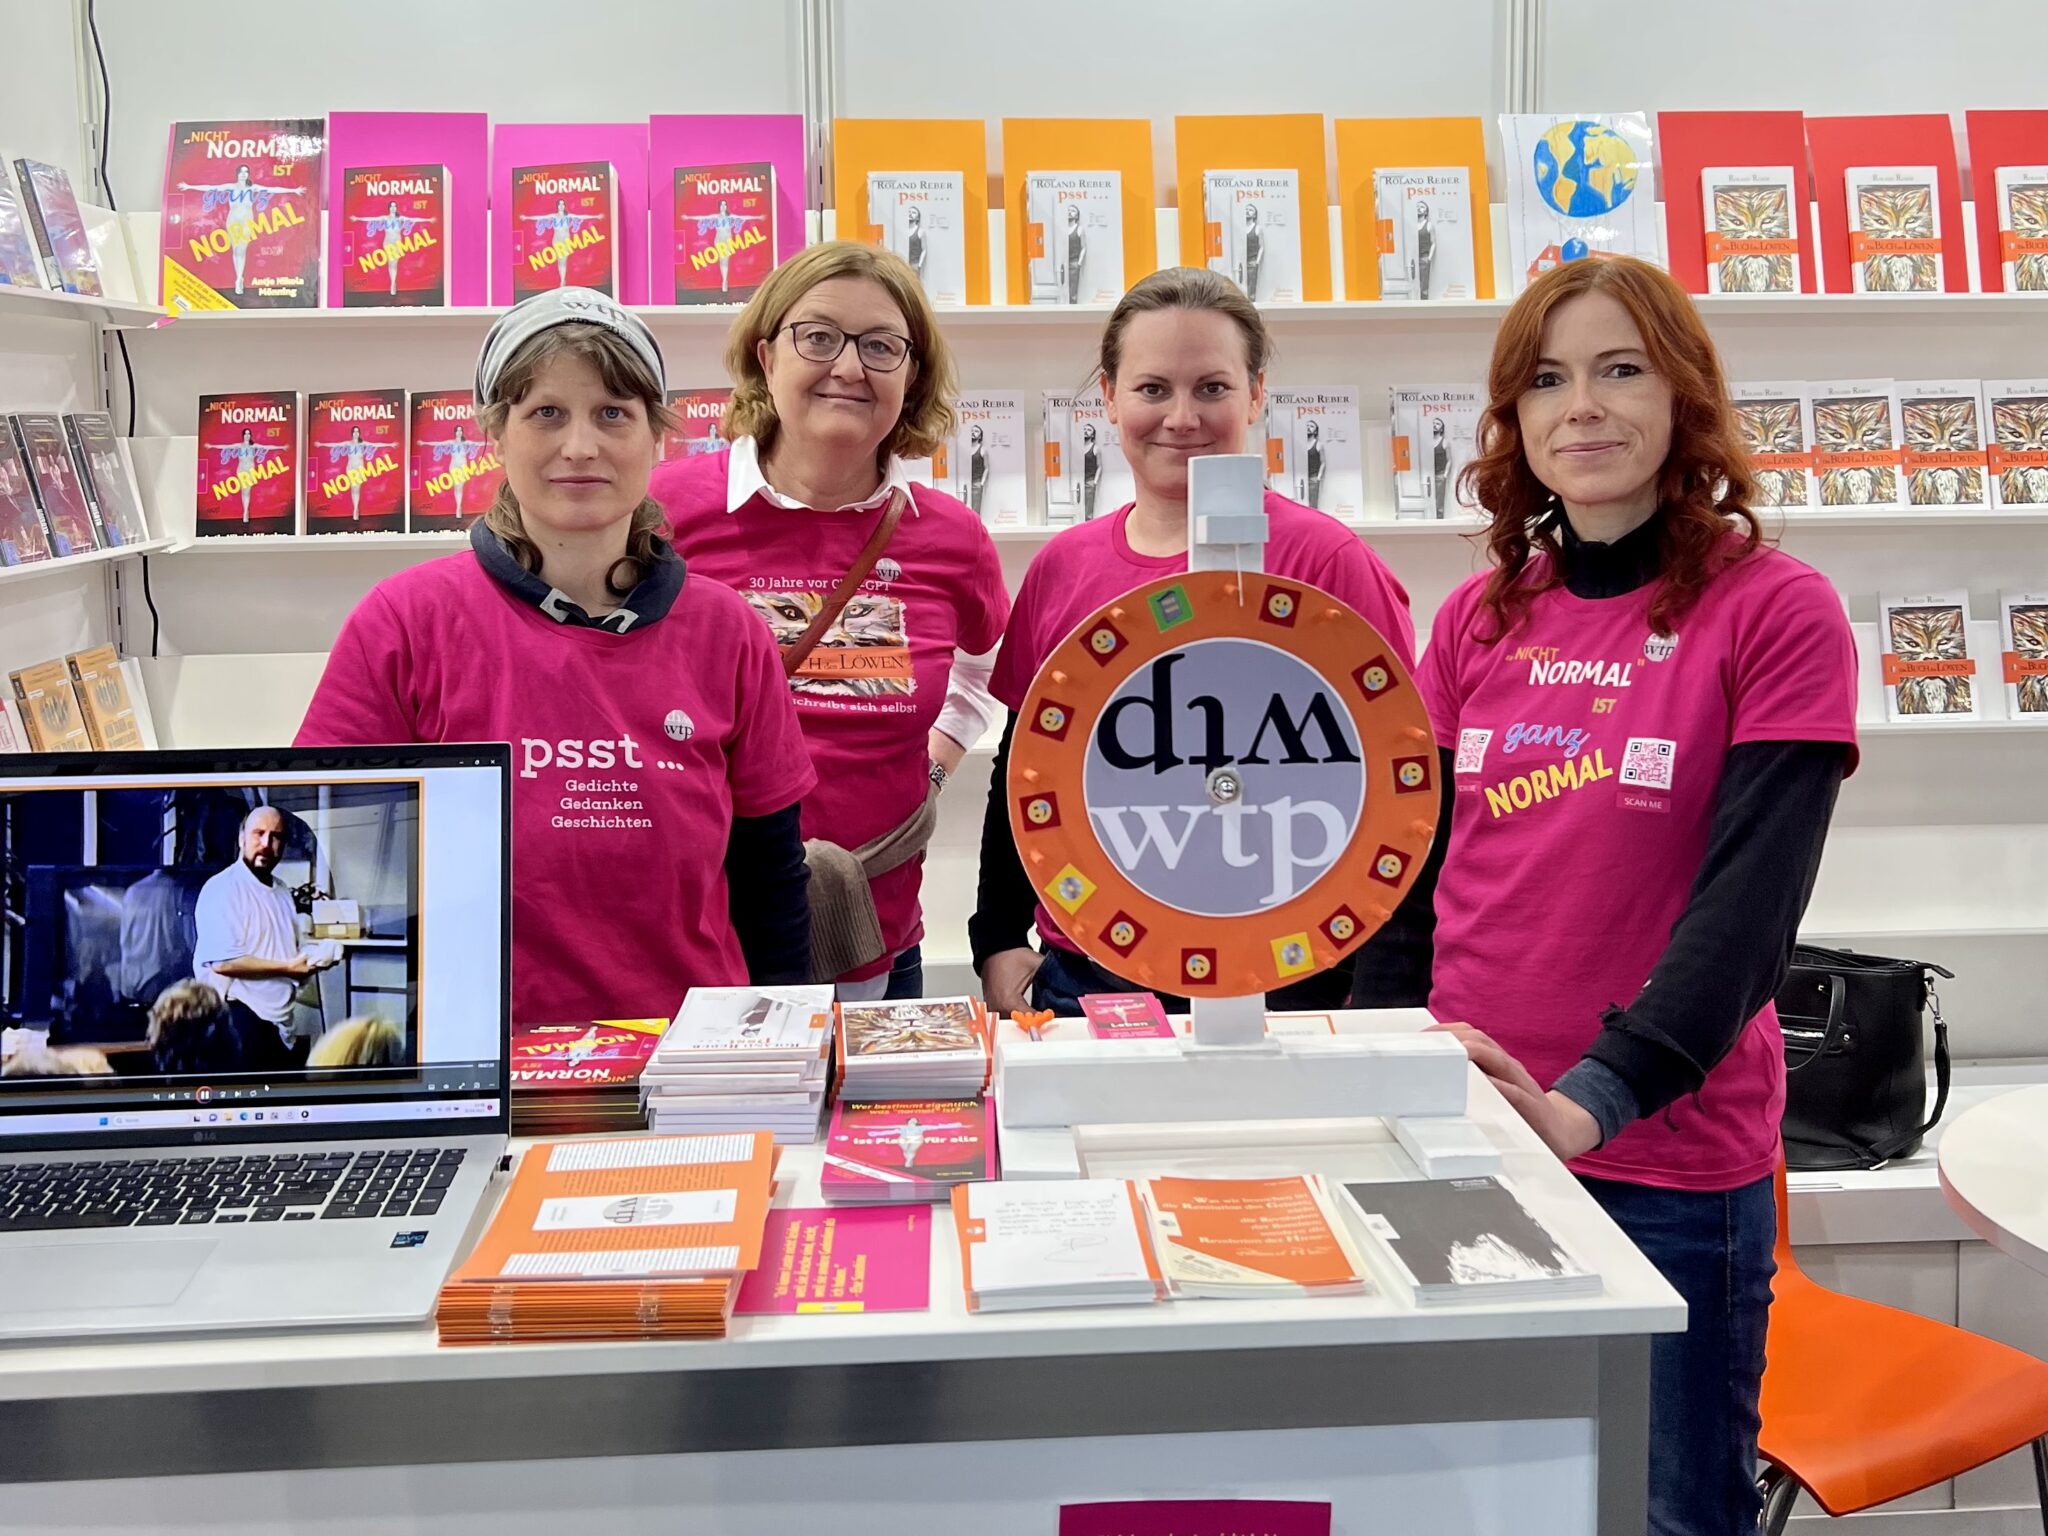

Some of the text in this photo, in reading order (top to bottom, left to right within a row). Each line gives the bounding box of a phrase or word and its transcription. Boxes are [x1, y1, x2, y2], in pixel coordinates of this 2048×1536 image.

[273, 165, 294, 177] IST
[877, 180, 953, 190] ROLAND REBER
[1036, 179, 1112, 190] ROLAND REBER
[1213, 178, 1289, 189] ROLAND REBER
[1385, 175, 1460, 186] ROLAND REBER
[899, 190, 929, 205] psst
[1058, 190, 1088, 203] psst
[1235, 189, 1265, 203] psst
[1406, 185, 1437, 200] psst
[202, 188, 273, 212] ganz
[413, 200, 427, 209] IST
[580, 197, 595, 207] IST
[743, 198, 757, 208] IST
[189, 202, 306, 262] NORMAL
[358, 228, 437, 273] NORMAL
[528, 225, 605, 272] NORMAL
[689, 226, 767, 271] NORMAL
[563, 301, 628, 326] wtp
[982, 399, 1015, 408] REBER
[1053, 398, 1092, 407] ROLAND
[1275, 394, 1350, 404] ROLAND REBER
[1401, 392, 1475, 402] ROLAND REBER
[962, 409, 991, 424] psst
[1074, 409, 1103, 422] psst
[1296, 404, 1327, 419] psst
[1423, 403, 1453, 416] psst
[266, 427, 281, 437] IST
[375, 425, 390, 434] IST
[212, 456, 290, 501] NORMAL
[322, 453, 399, 499] NORMAL
[425, 453, 501, 497] NORMAL
[876, 568, 901, 582] wtp
[749, 577, 765, 589] 30
[768, 577, 804, 590] Jahre
[807, 579, 829, 589] vor
[840, 653, 904, 670] LÖWEN
[793, 699, 917, 714] chreibt sich selbst
[1591, 697, 1617, 713] IST
[1096, 653, 1362, 776] wtp
[664, 724, 694, 741] wtp
[1503, 722, 1591, 758] ganz
[520, 733, 643, 778] psst
[565, 779, 639, 792] Gedichte
[1483, 747, 1614, 819] NORMAL
[560, 797, 643, 811] Gedanken
[1624, 797, 1663, 809] SCAN ME
[551, 815, 652, 829] Geschichten
[1088, 795, 1348, 905] wtp
[924, 1136, 947, 1144] für
[949, 1135, 979, 1144] alle
